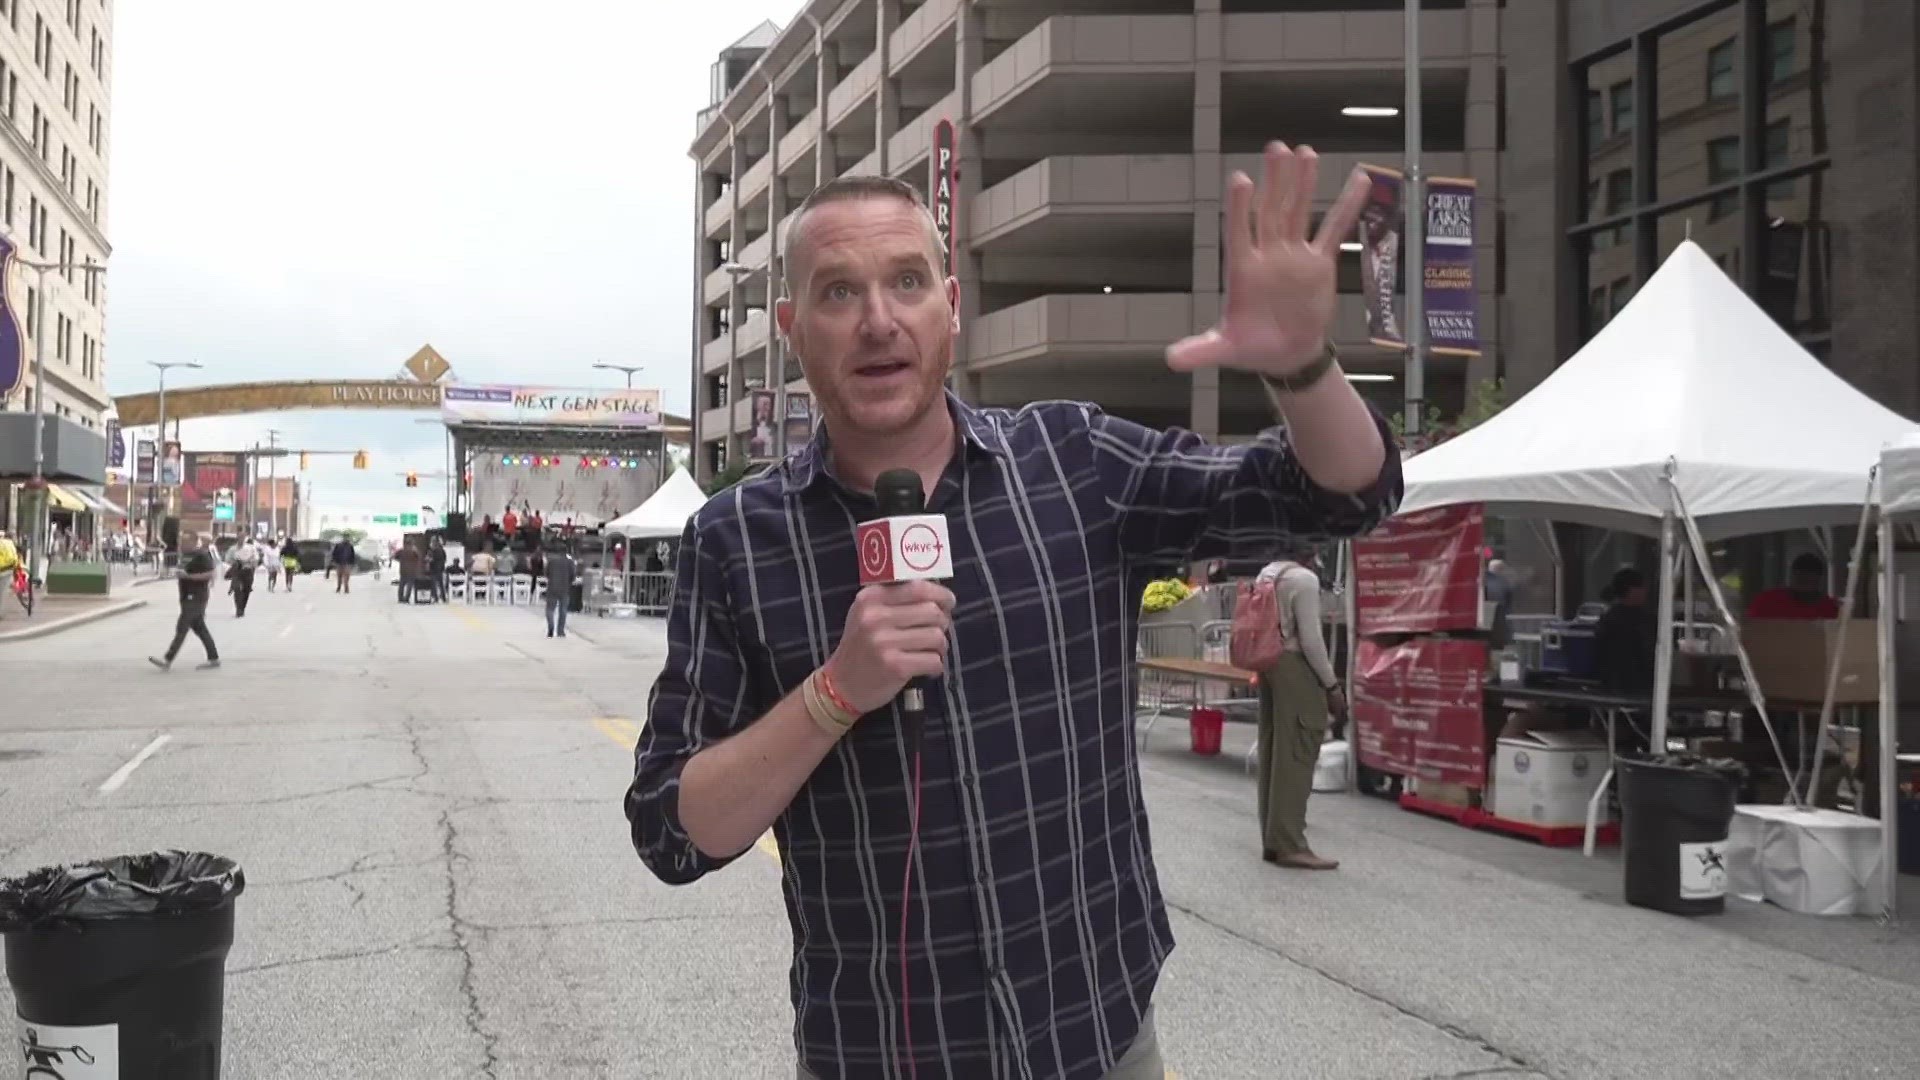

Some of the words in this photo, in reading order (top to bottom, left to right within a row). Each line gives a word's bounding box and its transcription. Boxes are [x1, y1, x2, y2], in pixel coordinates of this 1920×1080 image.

[1427, 194, 1471, 209] GREAT
[1427, 209, 1471, 225] LAKES
[1424, 267, 1471, 278] CLASSIC
[1424, 279, 1472, 288] COMPANY
[332, 385, 439, 402] PLAYHOUSE
[514, 394, 557, 410] NEXT
[561, 395, 598, 411] GEN
[601, 399, 653, 414] STAGE
[870, 538, 880, 565] 3
